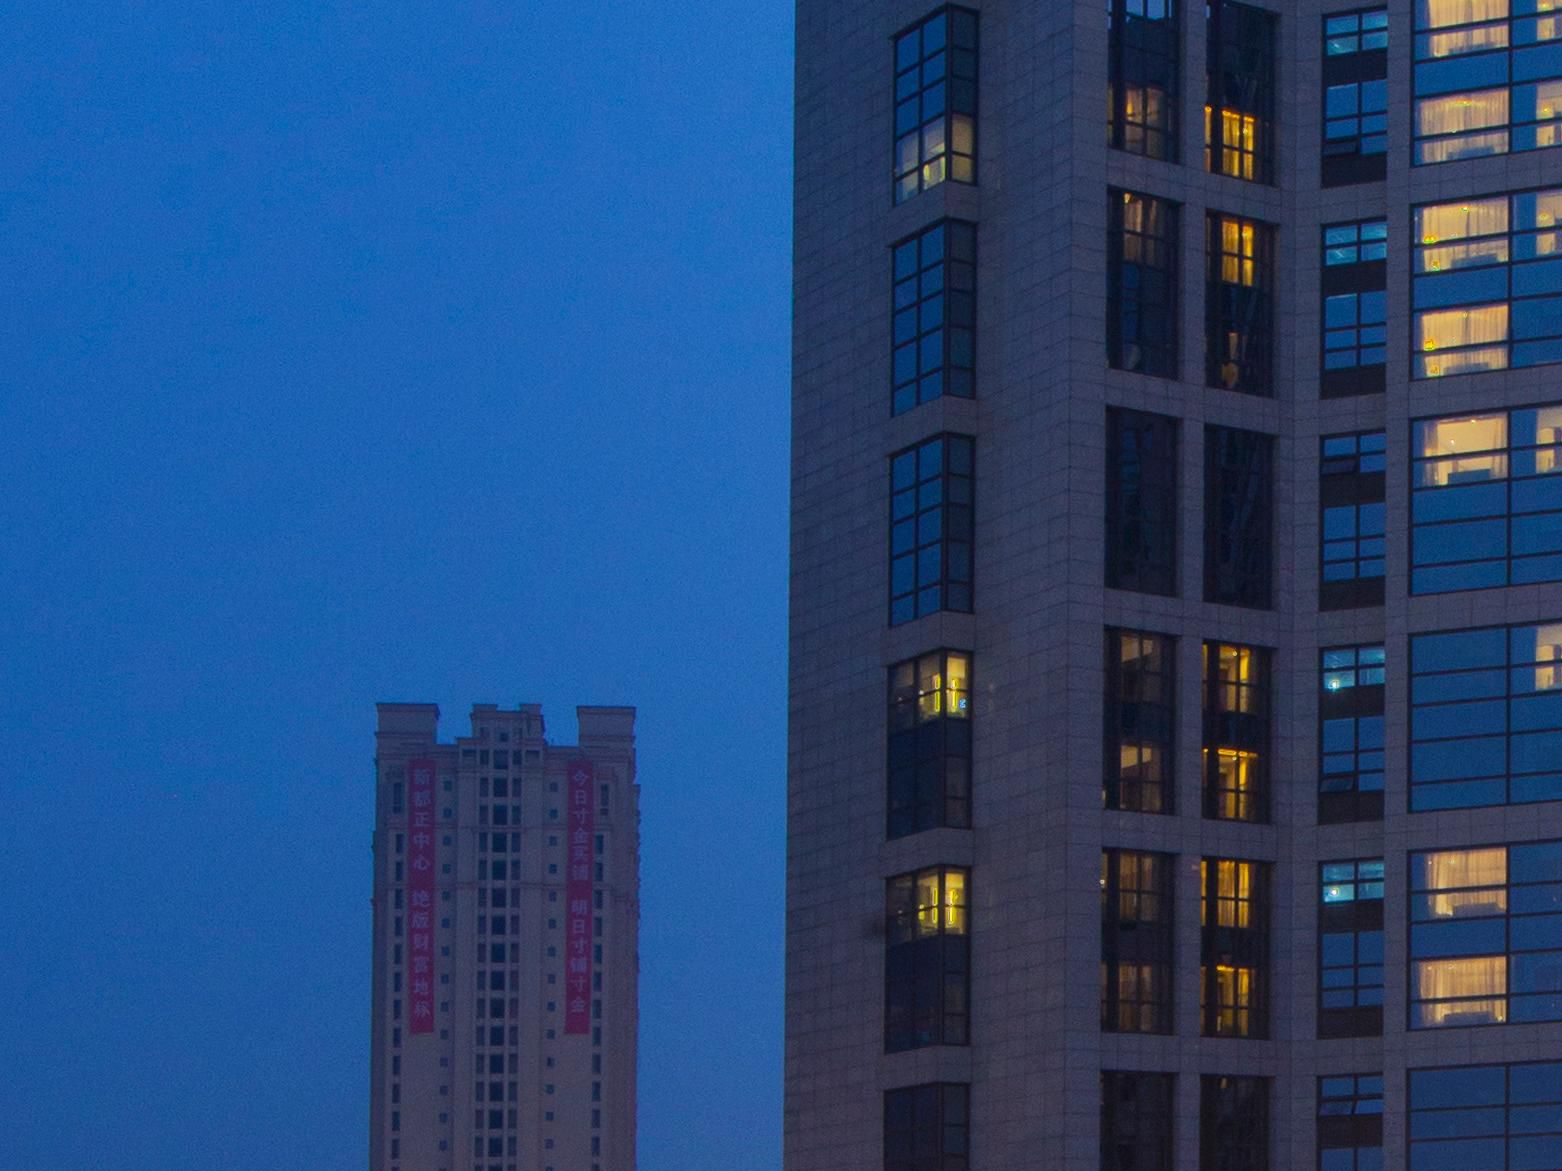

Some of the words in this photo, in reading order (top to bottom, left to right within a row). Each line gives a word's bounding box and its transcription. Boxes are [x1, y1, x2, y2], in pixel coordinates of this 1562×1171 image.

[412, 768, 432, 871] 新都正中心
